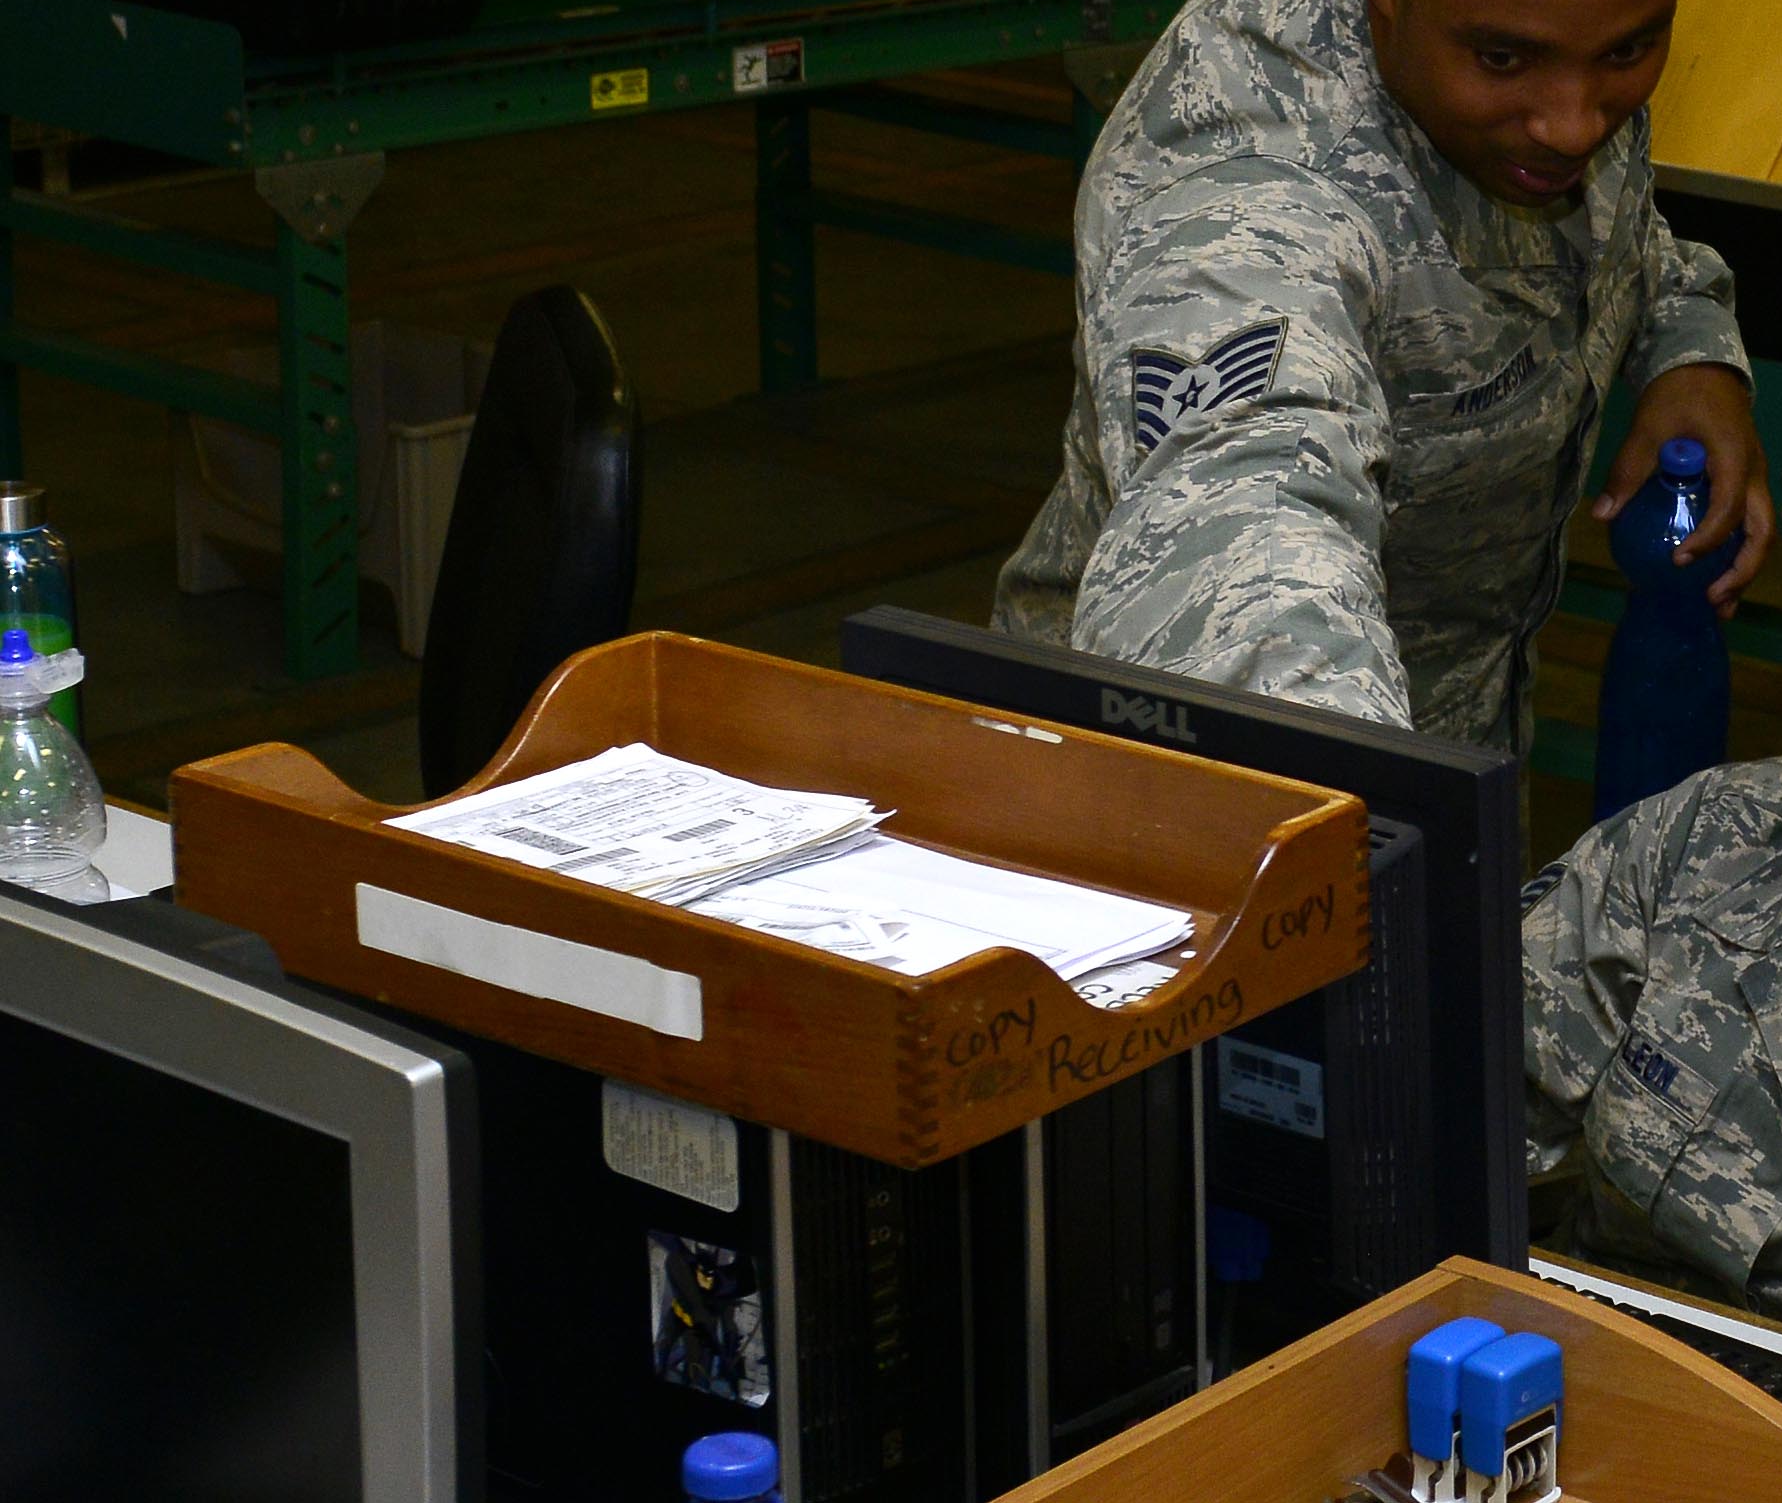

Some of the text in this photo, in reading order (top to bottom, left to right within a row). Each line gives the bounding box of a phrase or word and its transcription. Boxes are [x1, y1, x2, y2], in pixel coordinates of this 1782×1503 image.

[1450, 343, 1537, 417] ANDERSON
[1100, 687, 1198, 745] DELL
[1621, 1040, 1680, 1092] LEON
